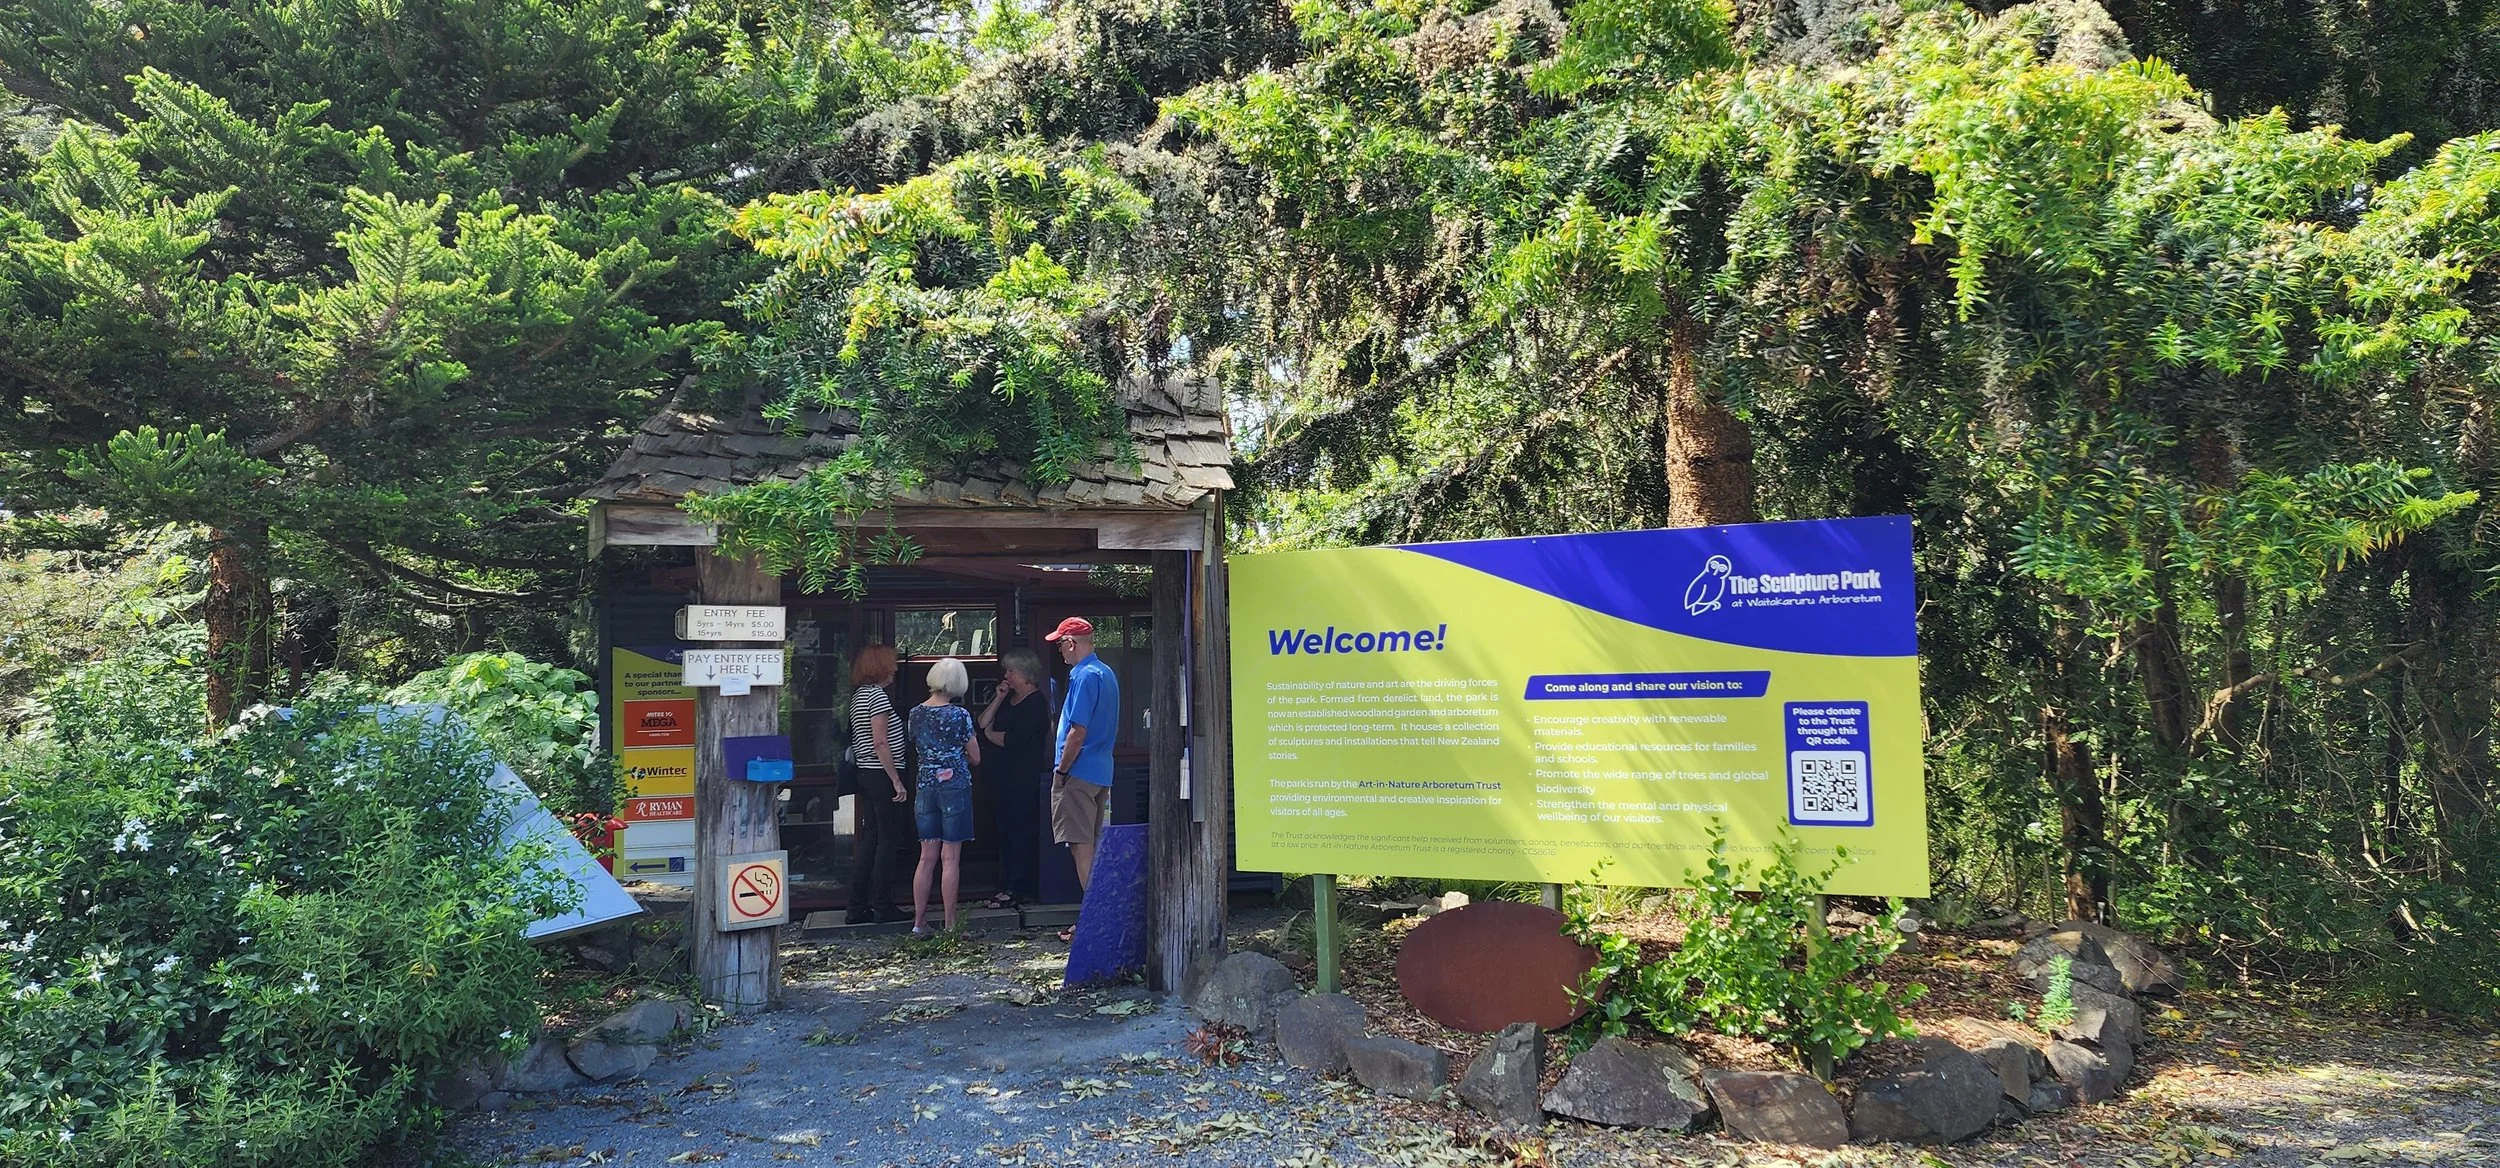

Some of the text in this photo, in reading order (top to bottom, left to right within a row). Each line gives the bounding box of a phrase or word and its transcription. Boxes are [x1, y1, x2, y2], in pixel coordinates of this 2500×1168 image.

[1729, 569, 1881, 594] The Sculpture Park
[1731, 594, 1881, 608] at Waitakaruru Arboretum
[704, 609, 765, 618] ENTRY FEE
[697, 620, 714, 628] 5yrs
[751, 630, 778, 638] $15.00
[1269, 624, 1447, 655] Welcome!
[688, 654, 711, 663] PAY
[714, 654, 752, 663] ENTRY
[755, 654, 780, 663] FEES
[633, 671, 662, 679] special
[720, 665, 749, 674] HERE
[1267, 681, 1324, 691] Sustainability
[1325, 681, 1334, 689] of
[1366, 680, 1384, 688] and
[1385, 680, 1399, 688] art
[1417, 679, 1432, 687] the
[1434, 678, 1467, 689] driving
[1468, 678, 1498, 687] forces
[1545, 680, 1743, 694] Come along and share our vision to:
[1267, 692, 1498, 705] of the park. Formed from derelict land, the park is
[1298, 709, 1348, 718] established
[1349, 708, 1394, 717] woodland
[1394, 708, 1427, 718] garden
[1428, 708, 1447, 716] and
[1447, 707, 1499, 716] arboretum
[1793, 707, 1861, 716] Please donate
[641, 718, 677, 727] MEGA
[1534, 713, 1728, 726] Encourage creativity with renewable
[1799, 717, 1856, 726] to the Trust
[1268, 723, 1294, 732] which
[1296, 723, 1303, 731] is
[1305, 723, 1347, 733] protected
[1349, 722, 1396, 733] long-term.
[1401, 722, 1408, 730] It
[1410, 722, 1443, 730] houses
[1453, 722, 1499, 731] collection
[1534, 727, 1583, 736] materials.
[1797, 726, 1859, 736] through this
[1268, 736, 1500, 747] of sculptures and installations that tell New Zealand
[1535, 741, 1757, 752] Provide educational resources for families
[1806, 737, 1851, 746] QR code.
[1268, 751, 1299, 760] stories.
[1536, 754, 1599, 764] and schools.
[647, 766, 687, 776] Wintec
[1536, 769, 1768, 782] Promote the wide range of trees and global
[1270, 779, 1286, 788] The
[1286, 779, 1306, 789] park
[1306, 780, 1314, 788] is
[1331, 780, 1341, 789] by
[1343, 779, 1358, 788] the
[1358, 780, 1420, 789] Art-in-Nature
[1421, 780, 1475, 789] Arboretum
[1475, 781, 1502, 790] Trust
[1536, 784, 1596, 796] biodiversity
[1270, 793, 1502, 806] providing environmental and creative inspiration for
[649, 801, 682, 811] RYMAN
[1536, 799, 1728, 814] Strengthen the mental and physical
[1270, 807, 1348, 818] visitors of all ages.
[1537, 812, 1587, 822] wellbeing
[1590, 812, 1600, 822] of
[1623, 813, 1664, 823] visitors.
[1271, 831, 1284, 839] The
[1286, 831, 1303, 839] Trust
[1304, 833, 1356, 841] acknowledges
[1371, 834, 1410, 842] significant
[1430, 836, 1462, 844] received
[1463, 836, 1482, 844] from
[1320, 842, 1431, 852] Art-in-Nature Arboretum Trust
